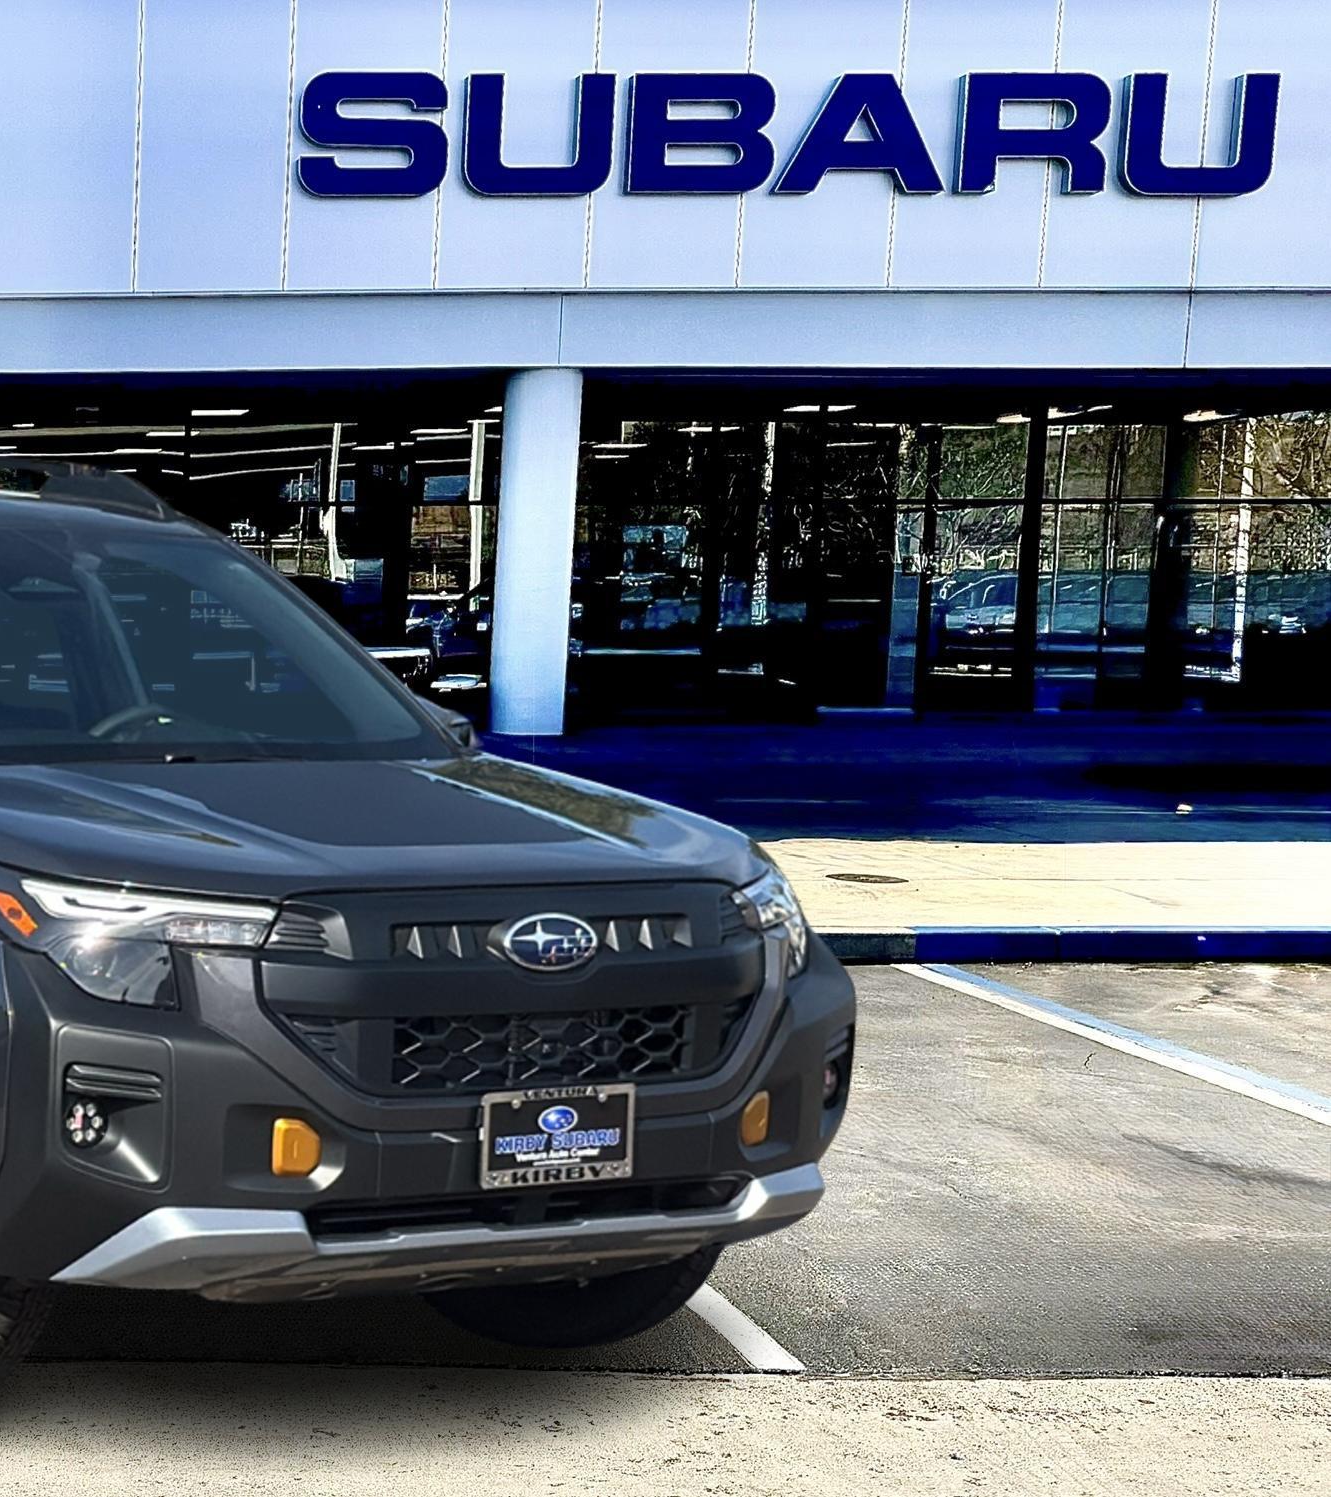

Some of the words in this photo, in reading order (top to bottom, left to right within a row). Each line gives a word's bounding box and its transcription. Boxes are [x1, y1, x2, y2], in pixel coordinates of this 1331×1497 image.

[297, 71, 1282, 197] SUBARU
[523, 1086, 600, 1101] VENTURA
[495, 1134, 548, 1155] KIRBY
[551, 1128, 620, 1149] SUBARU
[549, 1149, 569, 1159] Auto
[511, 1164, 605, 1184] KIRBY
